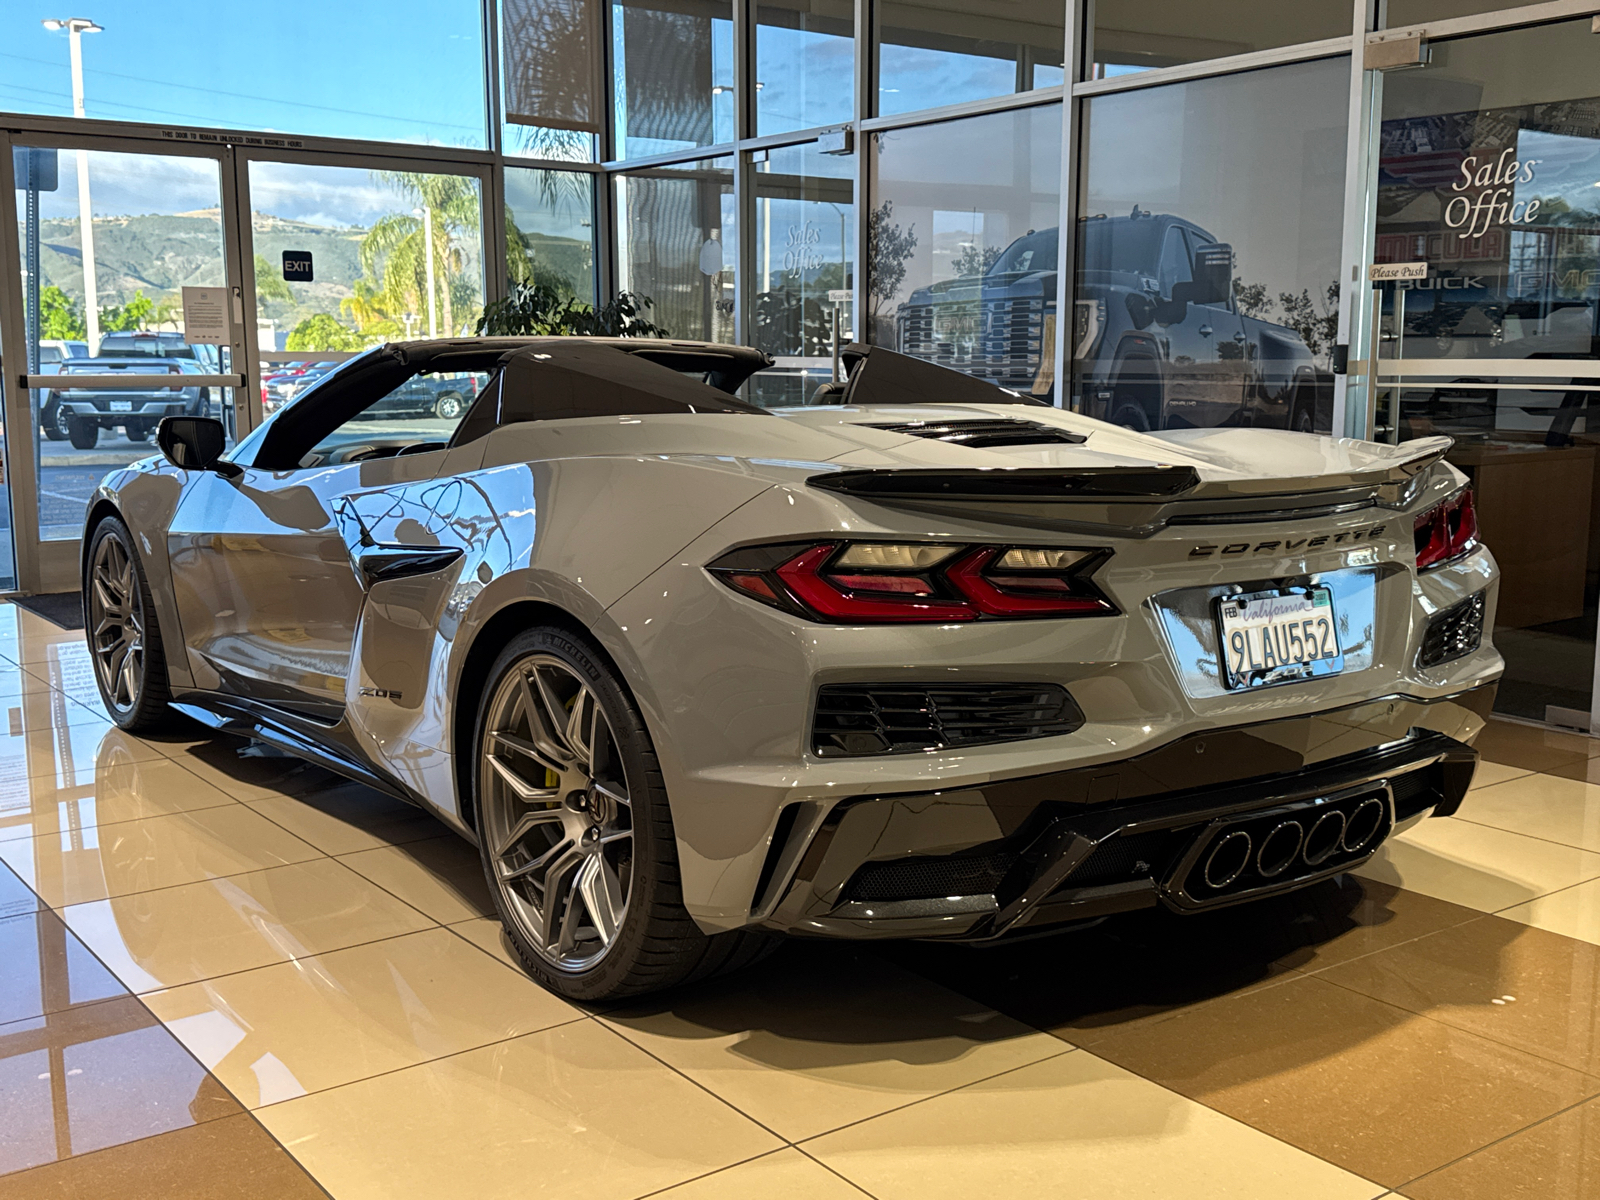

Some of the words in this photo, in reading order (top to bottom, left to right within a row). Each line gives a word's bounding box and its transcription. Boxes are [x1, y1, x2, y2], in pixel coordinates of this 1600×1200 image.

[162, 130, 173, 138] THIS
[175, 131, 188, 139] DOOR
[190, 132, 197, 140] TO
[199, 133, 218, 142] REMAIN
[220, 135, 243, 144] UNLOCKED
[245, 137, 263, 145] DURING
[264, 139, 286, 147] BUSINESS
[287, 140, 303, 148] HOURS
[1451, 147, 1543, 192] Sales
[1444, 188, 1541, 239] Office
[785, 220, 821, 247] Sales
[284, 260, 311, 272] EXIT
[783, 246, 824, 279] Office
[1370, 266, 1400, 279] Please
[1400, 264, 1425, 277] Push
[1396, 276, 1486, 290] BUICK
[935, 315, 987, 333] GMC
[1188, 525, 1387, 557] CORVETTE
[1224, 606, 1238, 619] FEB
[1243, 598, 1314, 624] California
[552, 636, 599, 679] MICHELIN
[1231, 618, 1334, 674] 9LAU552
